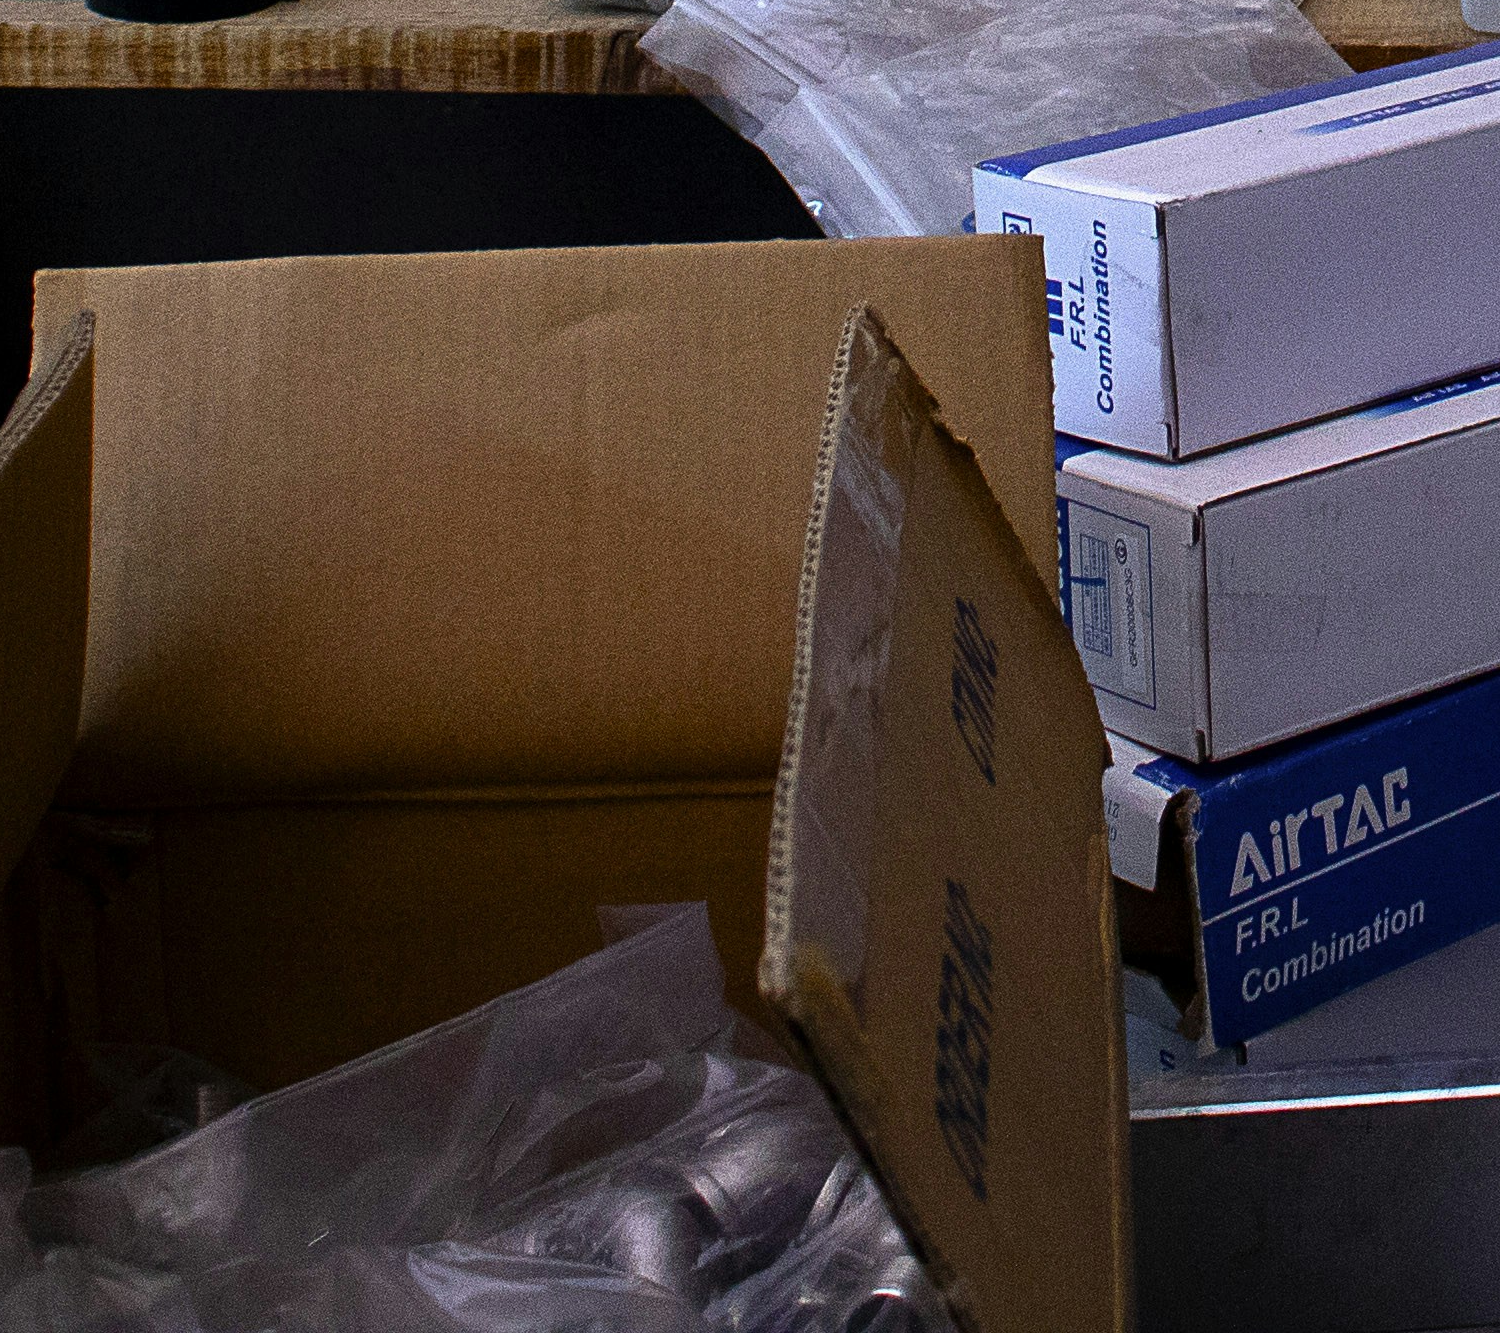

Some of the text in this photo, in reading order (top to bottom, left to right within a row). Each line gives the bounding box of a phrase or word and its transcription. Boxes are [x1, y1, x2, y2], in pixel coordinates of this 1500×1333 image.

[1068, 276, 1087, 351] F.R.L
[1091, 220, 1114, 414] Combination
[1235, 897, 1310, 955] F.R.L
[1240, 899, 1426, 1003] Combination
